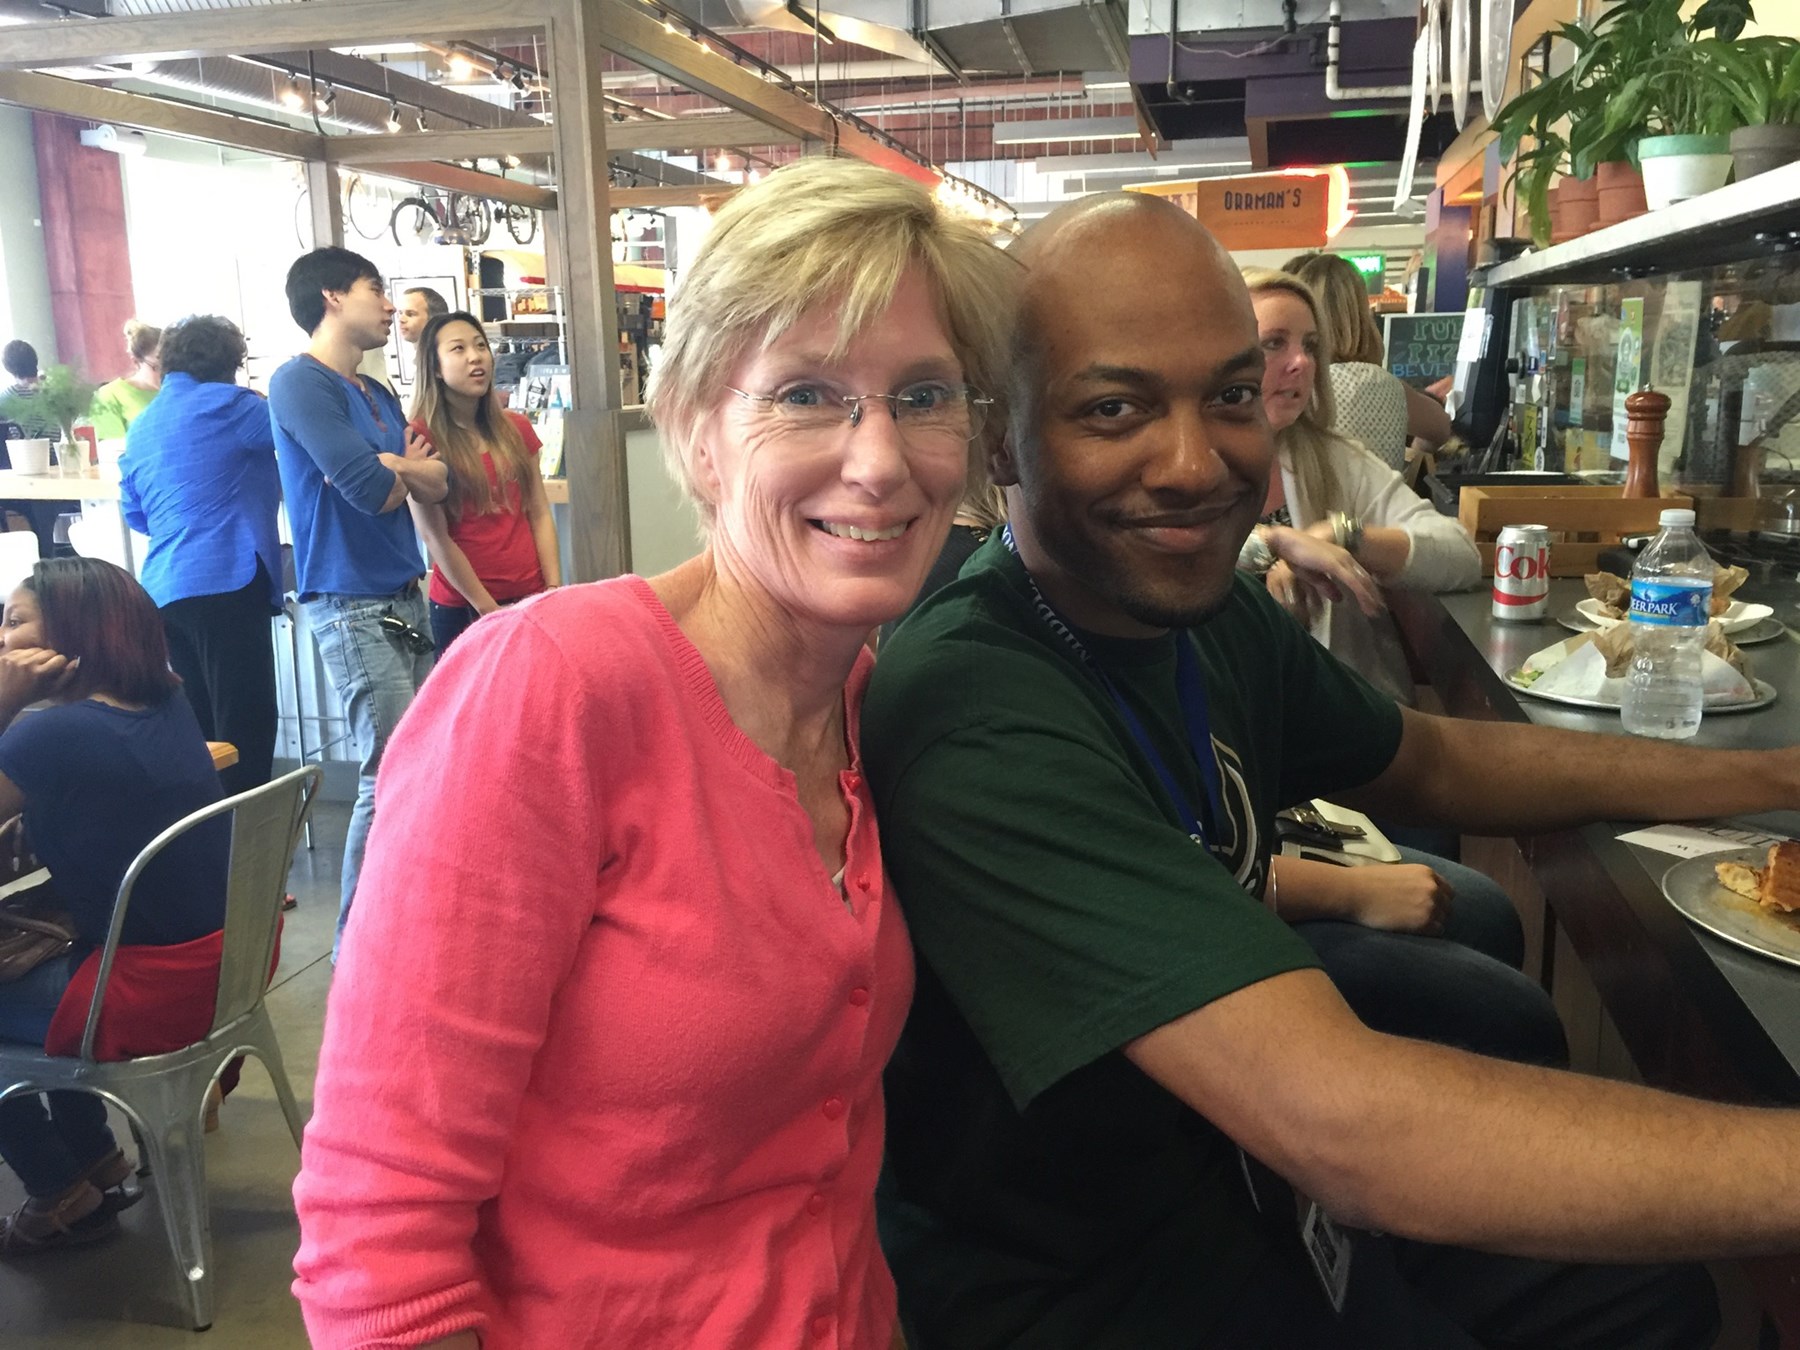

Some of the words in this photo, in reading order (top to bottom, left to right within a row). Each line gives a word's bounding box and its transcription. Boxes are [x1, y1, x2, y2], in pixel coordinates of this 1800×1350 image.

[1408, 343, 1459, 365] PIZ
[1494, 545, 1551, 580] Cok
[1631, 599, 1647, 612] EER
[1648, 602, 1678, 616] PARK
